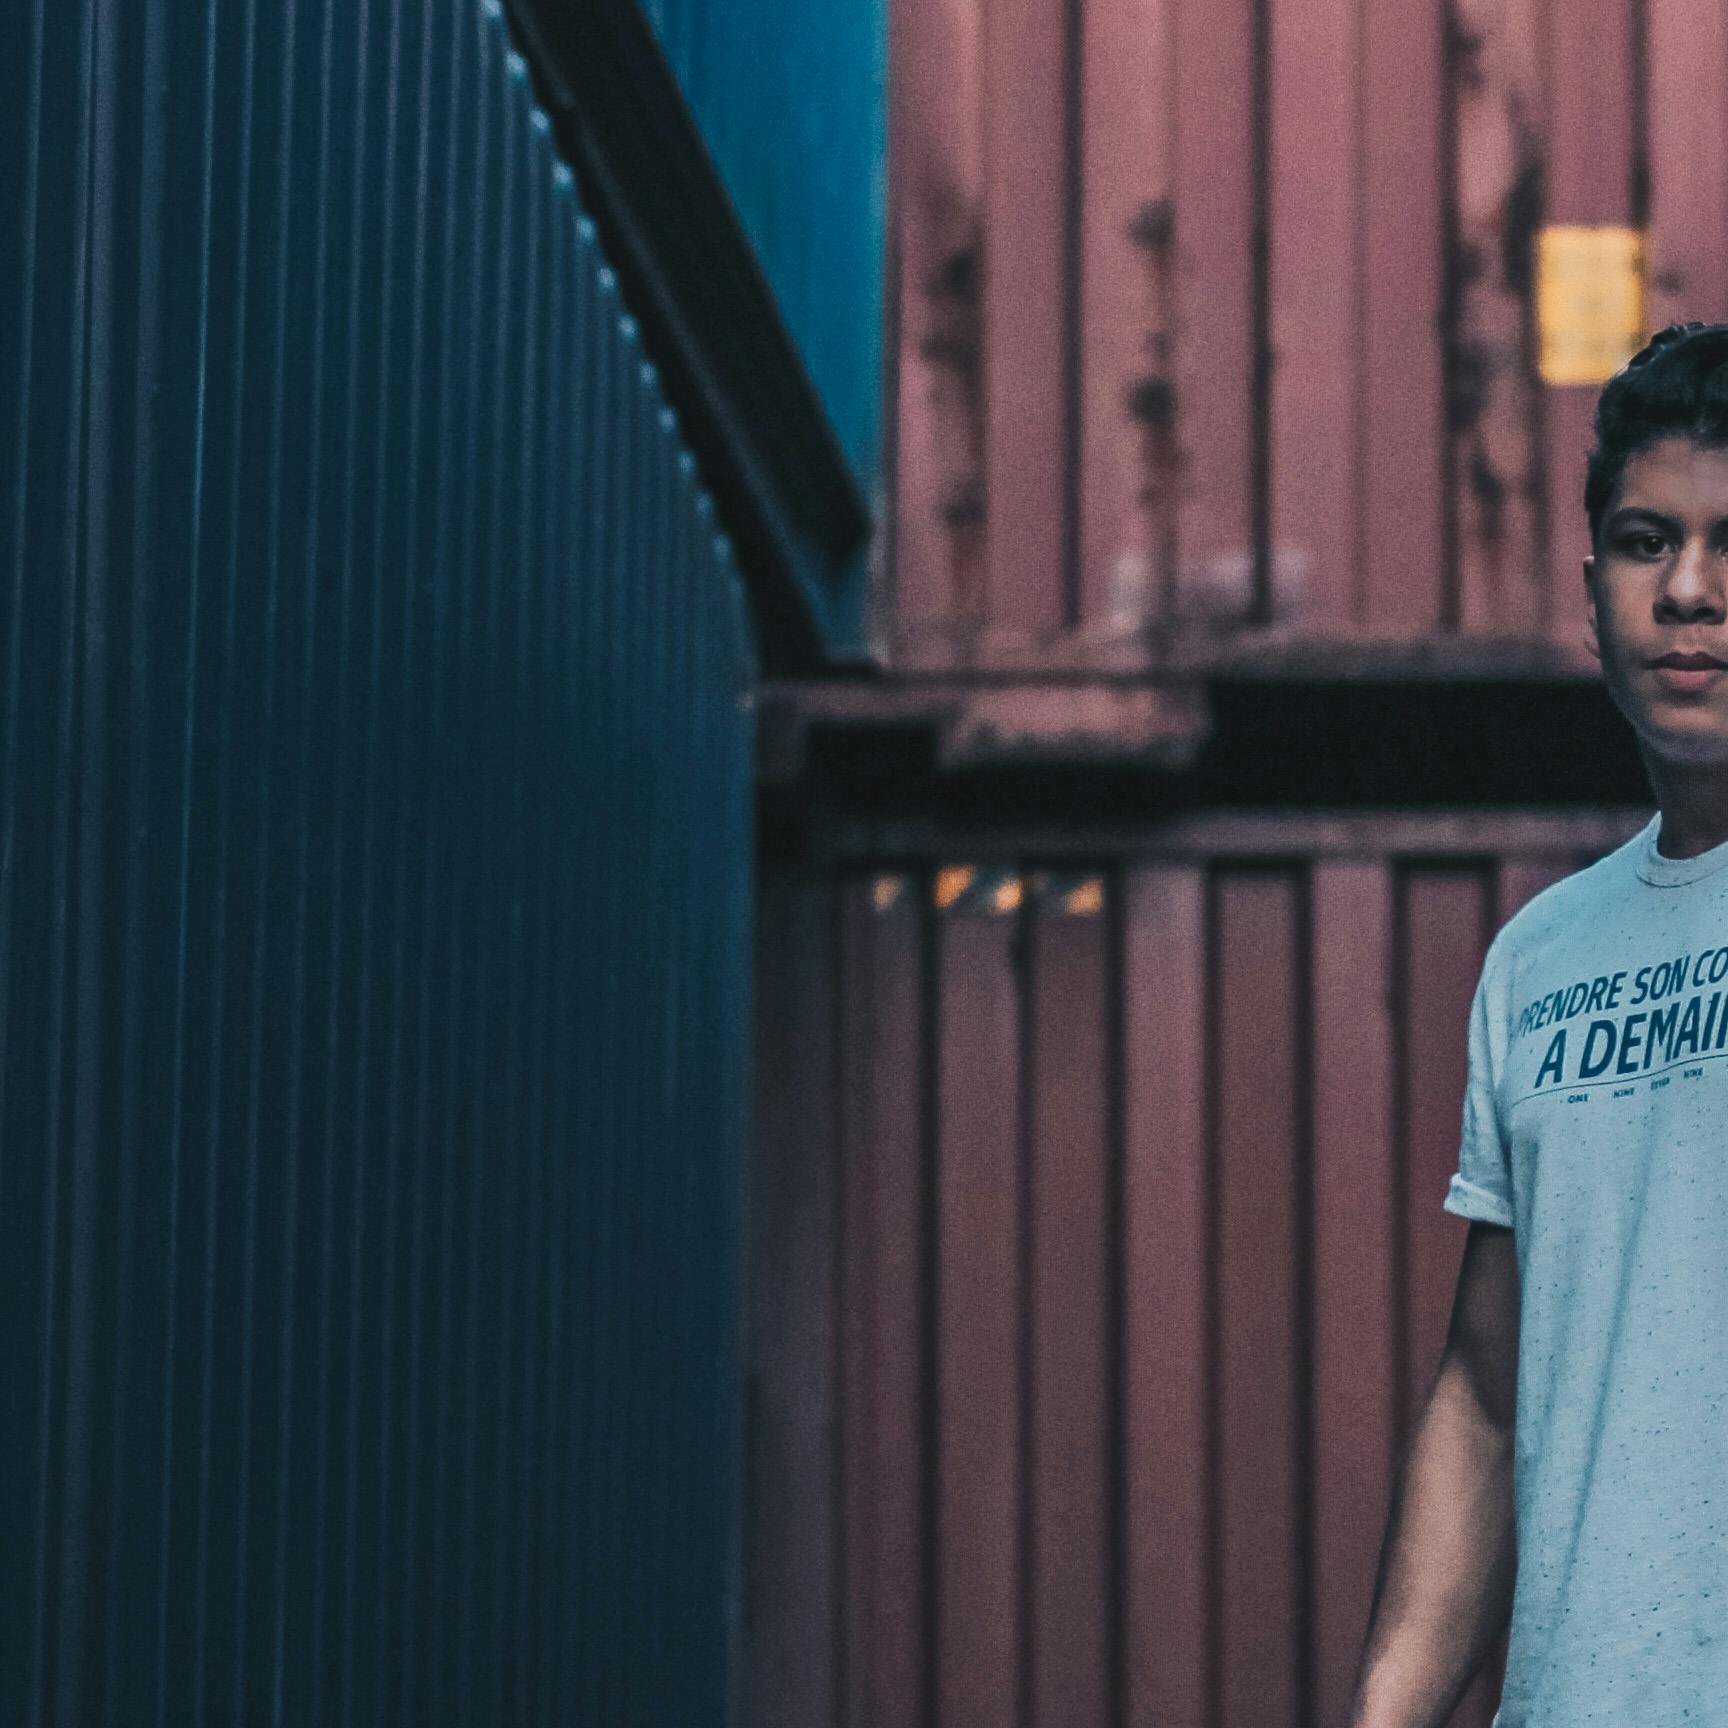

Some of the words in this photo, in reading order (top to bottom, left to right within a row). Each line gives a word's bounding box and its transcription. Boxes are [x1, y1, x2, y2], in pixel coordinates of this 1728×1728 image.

[1519, 972, 1628, 1037] PRENDRE
[1630, 955, 1690, 1005] SON
[1534, 1029, 1567, 1088] A
